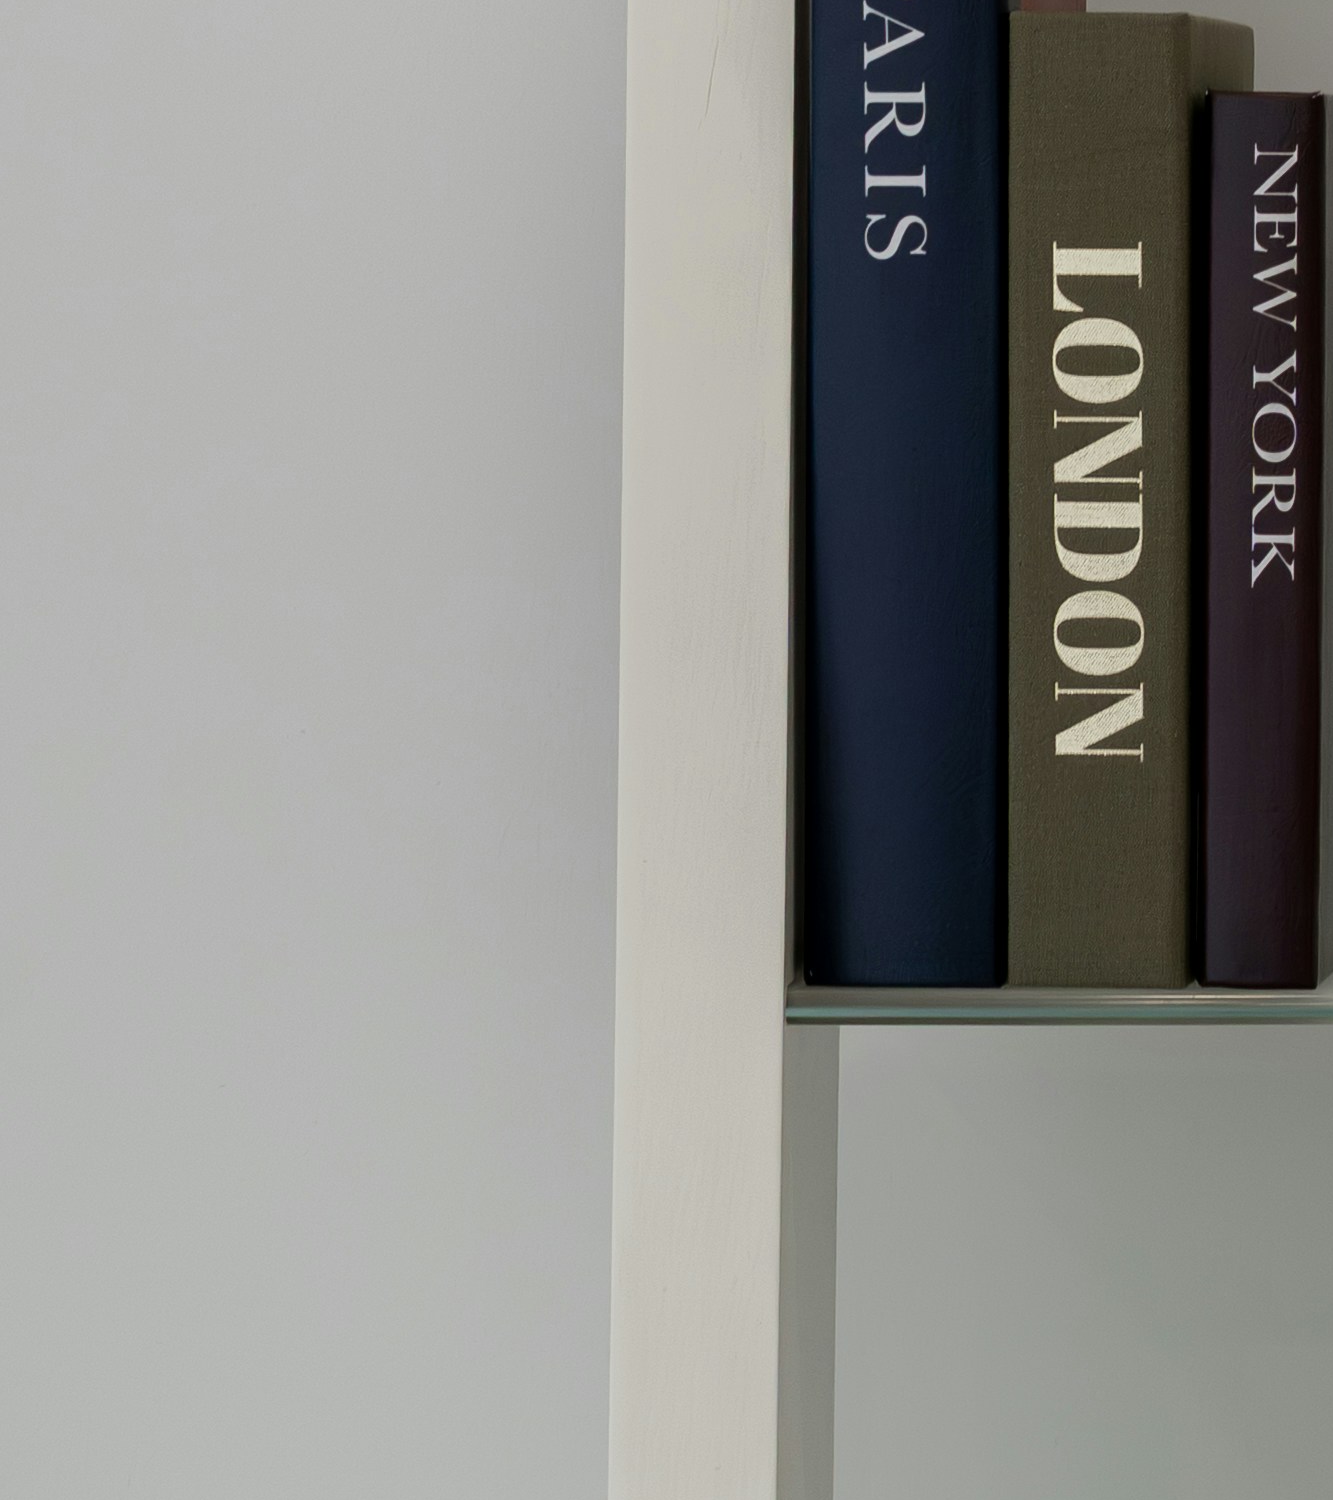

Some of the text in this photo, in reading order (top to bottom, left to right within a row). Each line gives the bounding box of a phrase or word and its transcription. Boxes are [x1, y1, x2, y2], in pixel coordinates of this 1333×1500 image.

[1051, 240, 1145, 763] LONDON
[1250, 142, 1299, 589] NEW YORK
